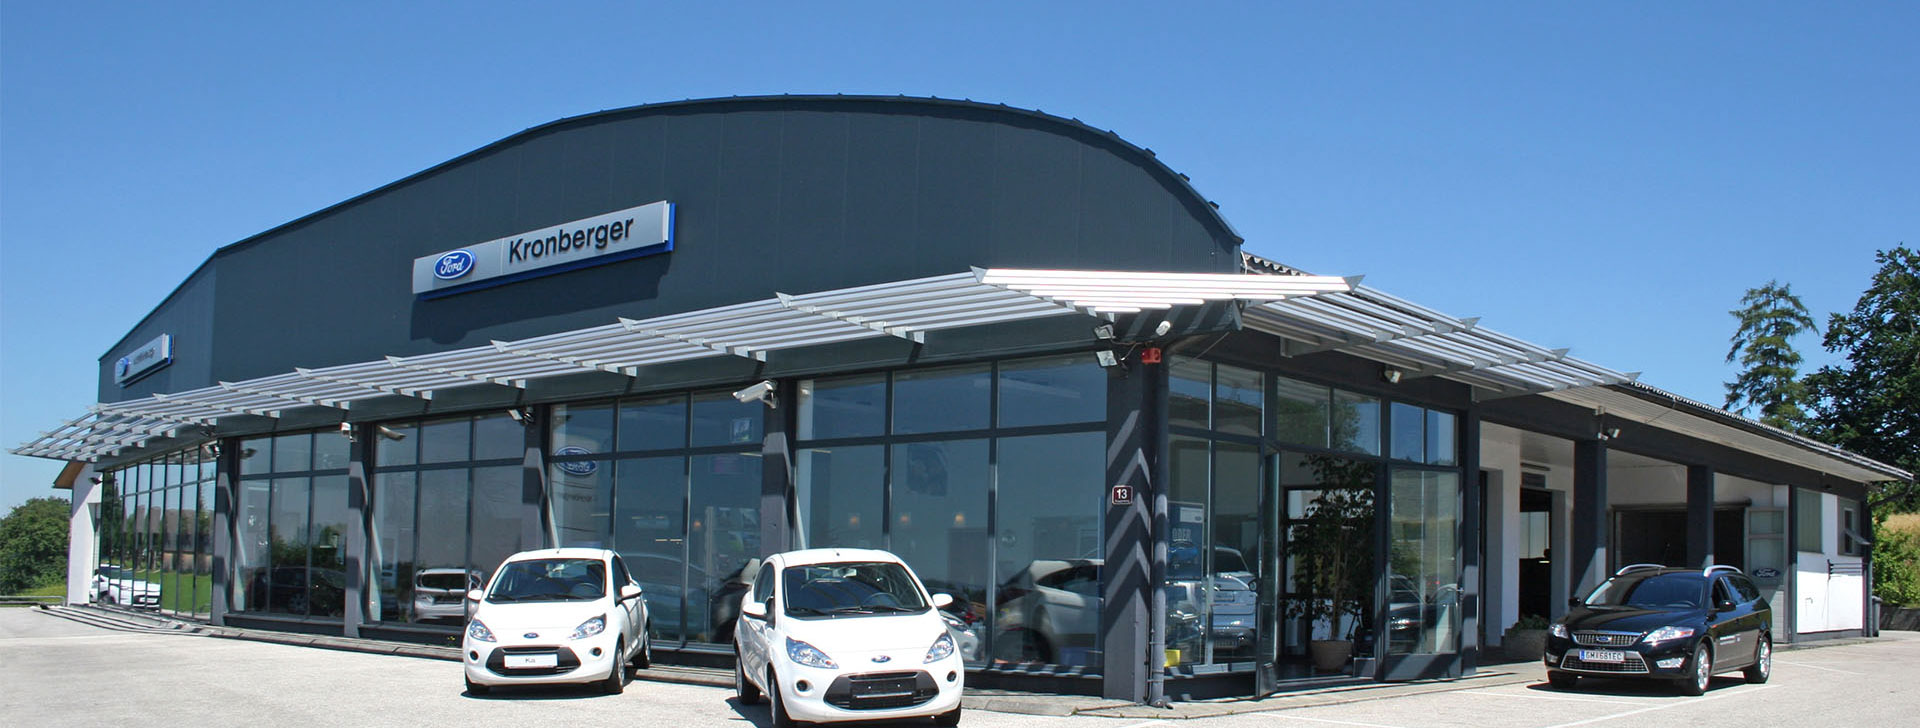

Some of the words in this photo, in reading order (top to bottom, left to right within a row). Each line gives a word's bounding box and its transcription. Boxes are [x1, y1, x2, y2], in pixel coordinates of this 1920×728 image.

[440, 254, 464, 274] Ford
[509, 217, 634, 264] Kronberger
[1116, 488, 1128, 499] 13
[1756, 568, 1777, 577] Ford
